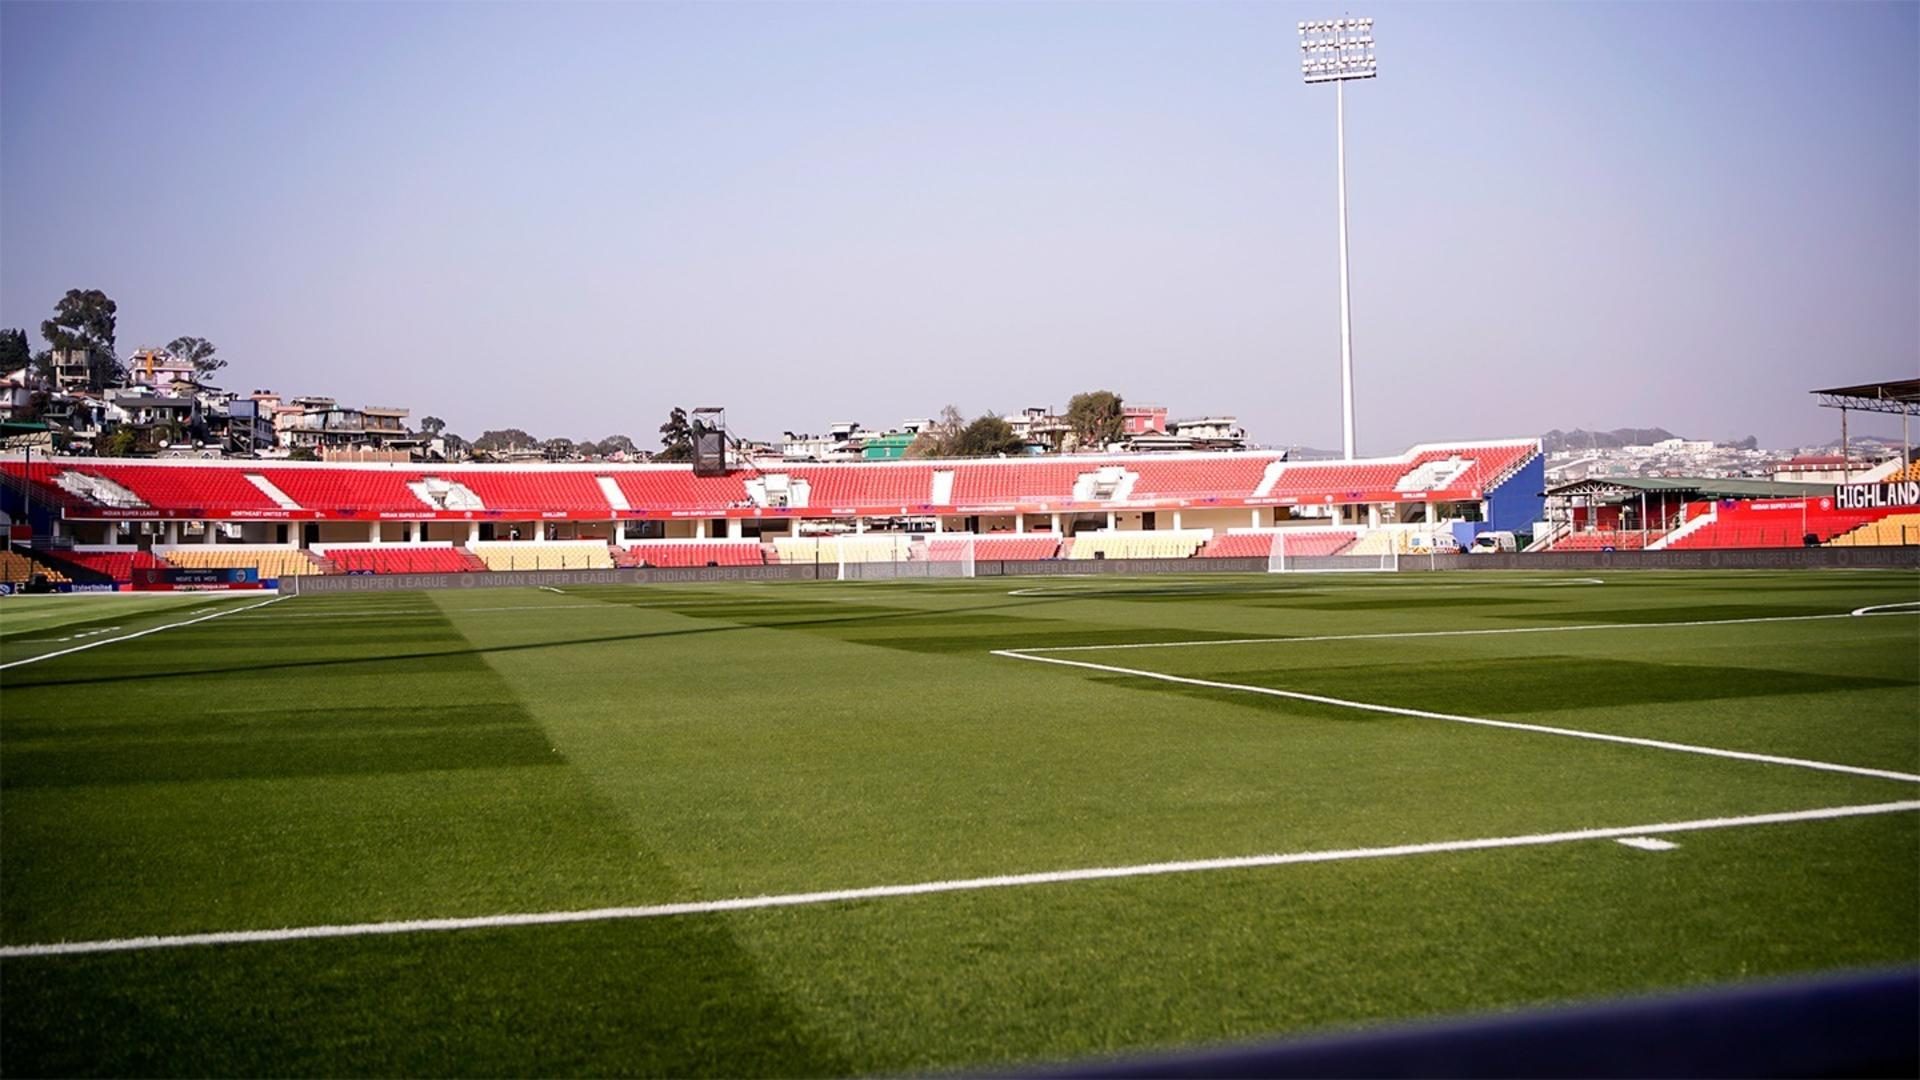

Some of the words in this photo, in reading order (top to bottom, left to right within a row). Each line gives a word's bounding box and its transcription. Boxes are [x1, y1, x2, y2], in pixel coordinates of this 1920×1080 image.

[1836, 481, 1920, 509] HIGHLAND
[1756, 552, 1786, 565] SUPER
[1789, 551, 1827, 564] LEAGUE
[1022, 563, 1060, 574] SUPER
[1062, 562, 1104, 573] LEAGUE
[1132, 561, 1171, 572] INDIAN
[1172, 561, 1208, 571] SUPER
[1210, 560, 1249, 570] LEAGUE
[480, 575, 525, 586] INDIAN
[528, 574, 570, 585] SUPER
[574, 572, 622, 584] LEAGUE
[654, 570, 695, 582] INDIAN
[700, 569, 739, 581] SUPER
[743, 568, 790, 579] LEAGUE
[302, 579, 347, 590] INDIAN
[351, 577, 393, 589] SUPER
[398, 576, 448, 588] LEAGUE
